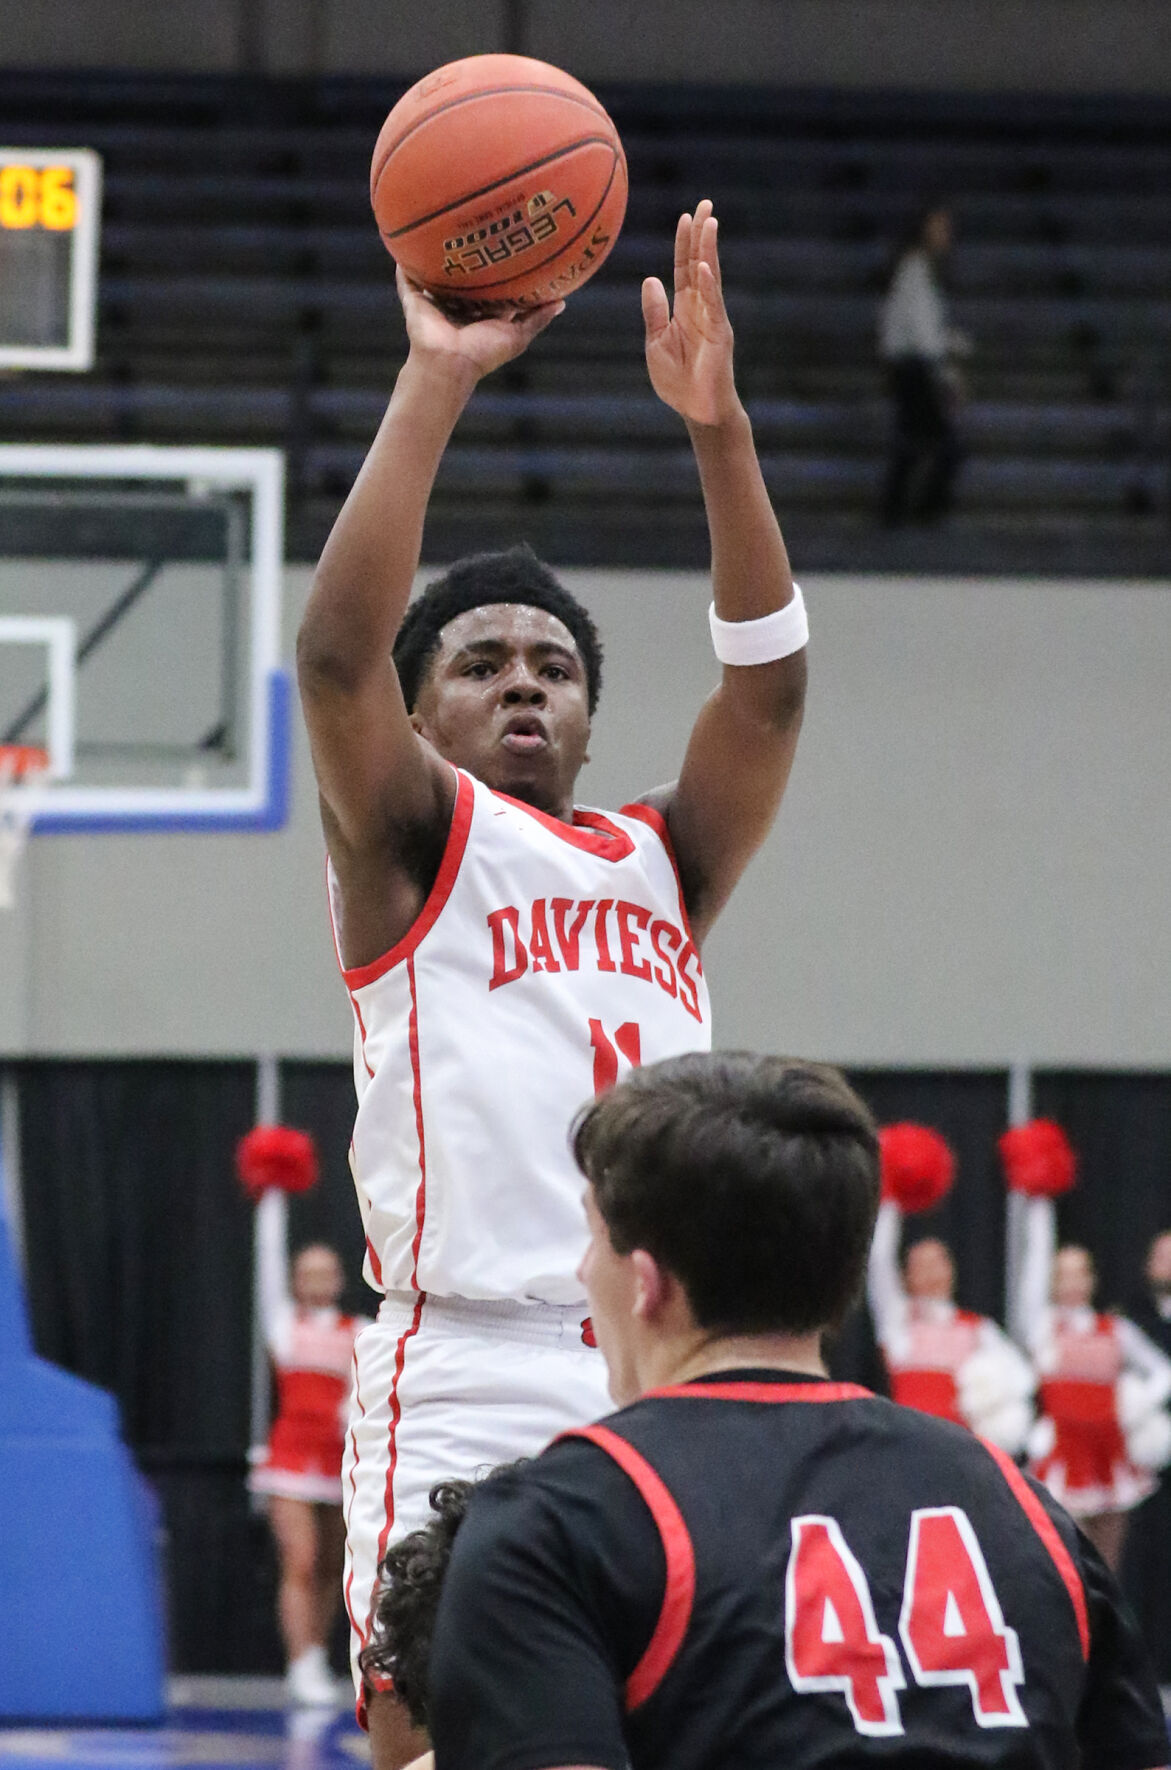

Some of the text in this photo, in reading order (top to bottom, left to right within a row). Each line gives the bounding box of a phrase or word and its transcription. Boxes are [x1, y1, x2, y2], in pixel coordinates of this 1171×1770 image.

[0, 164, 79, 231] 06
[443, 197, 577, 278] LEGACY
[785, 1505, 1029, 1737] 44
